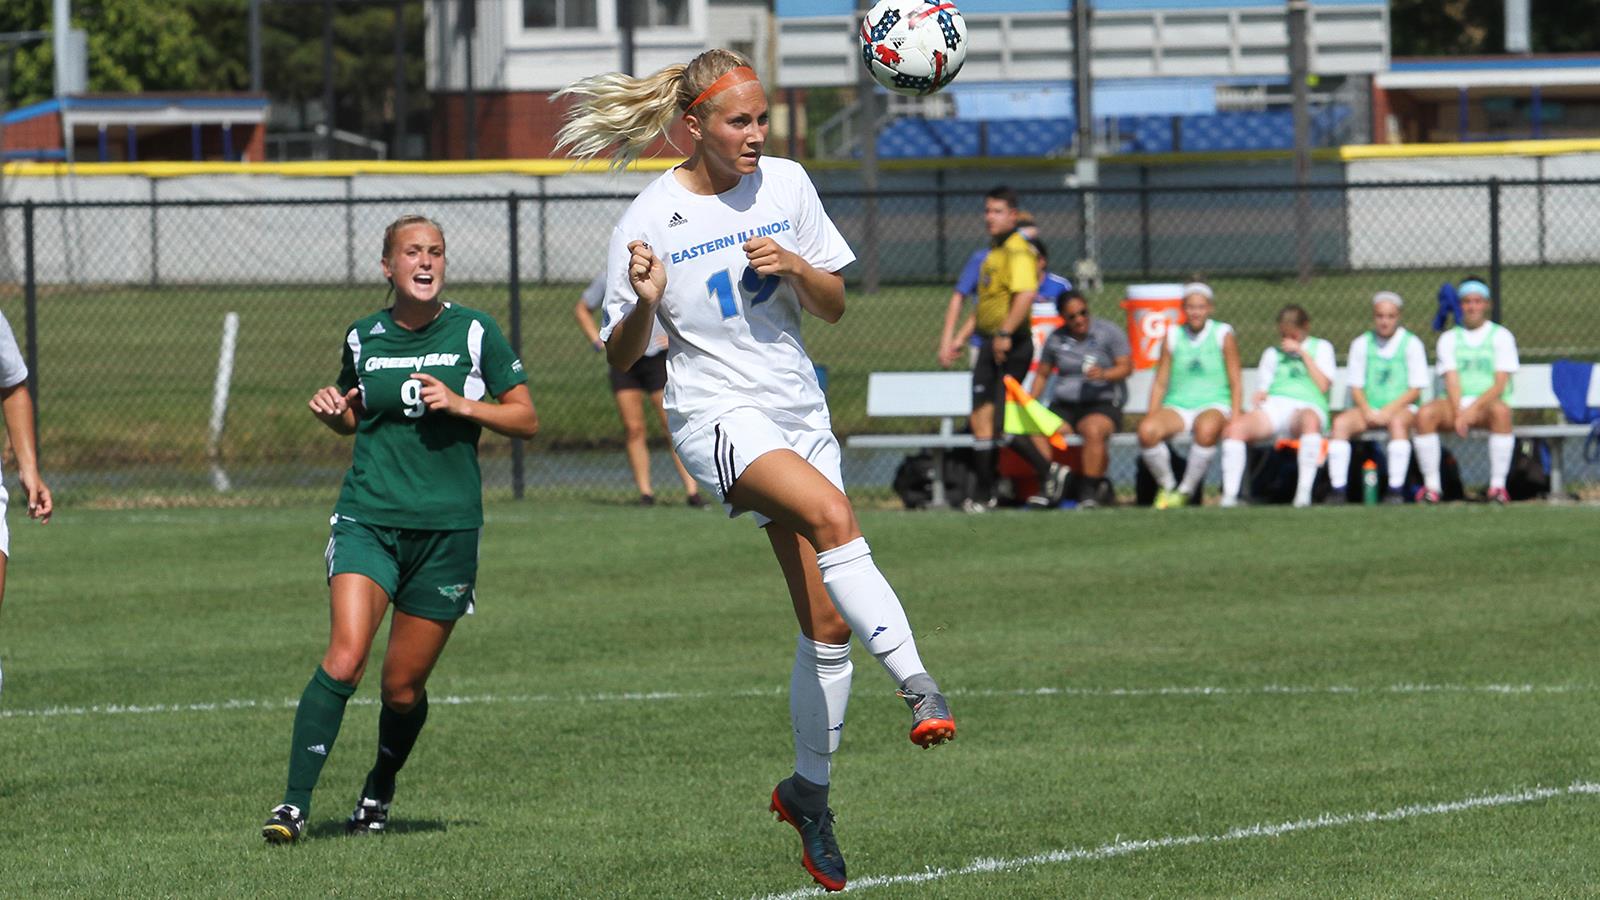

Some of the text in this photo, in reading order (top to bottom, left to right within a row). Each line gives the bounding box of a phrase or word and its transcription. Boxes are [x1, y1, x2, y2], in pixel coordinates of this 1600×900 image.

[667, 218, 688, 228] adidas
[671, 219, 791, 264] EASTERN ILLINOIS
[364, 353, 460, 372] GREEN BAY
[400, 379, 425, 418] 9
